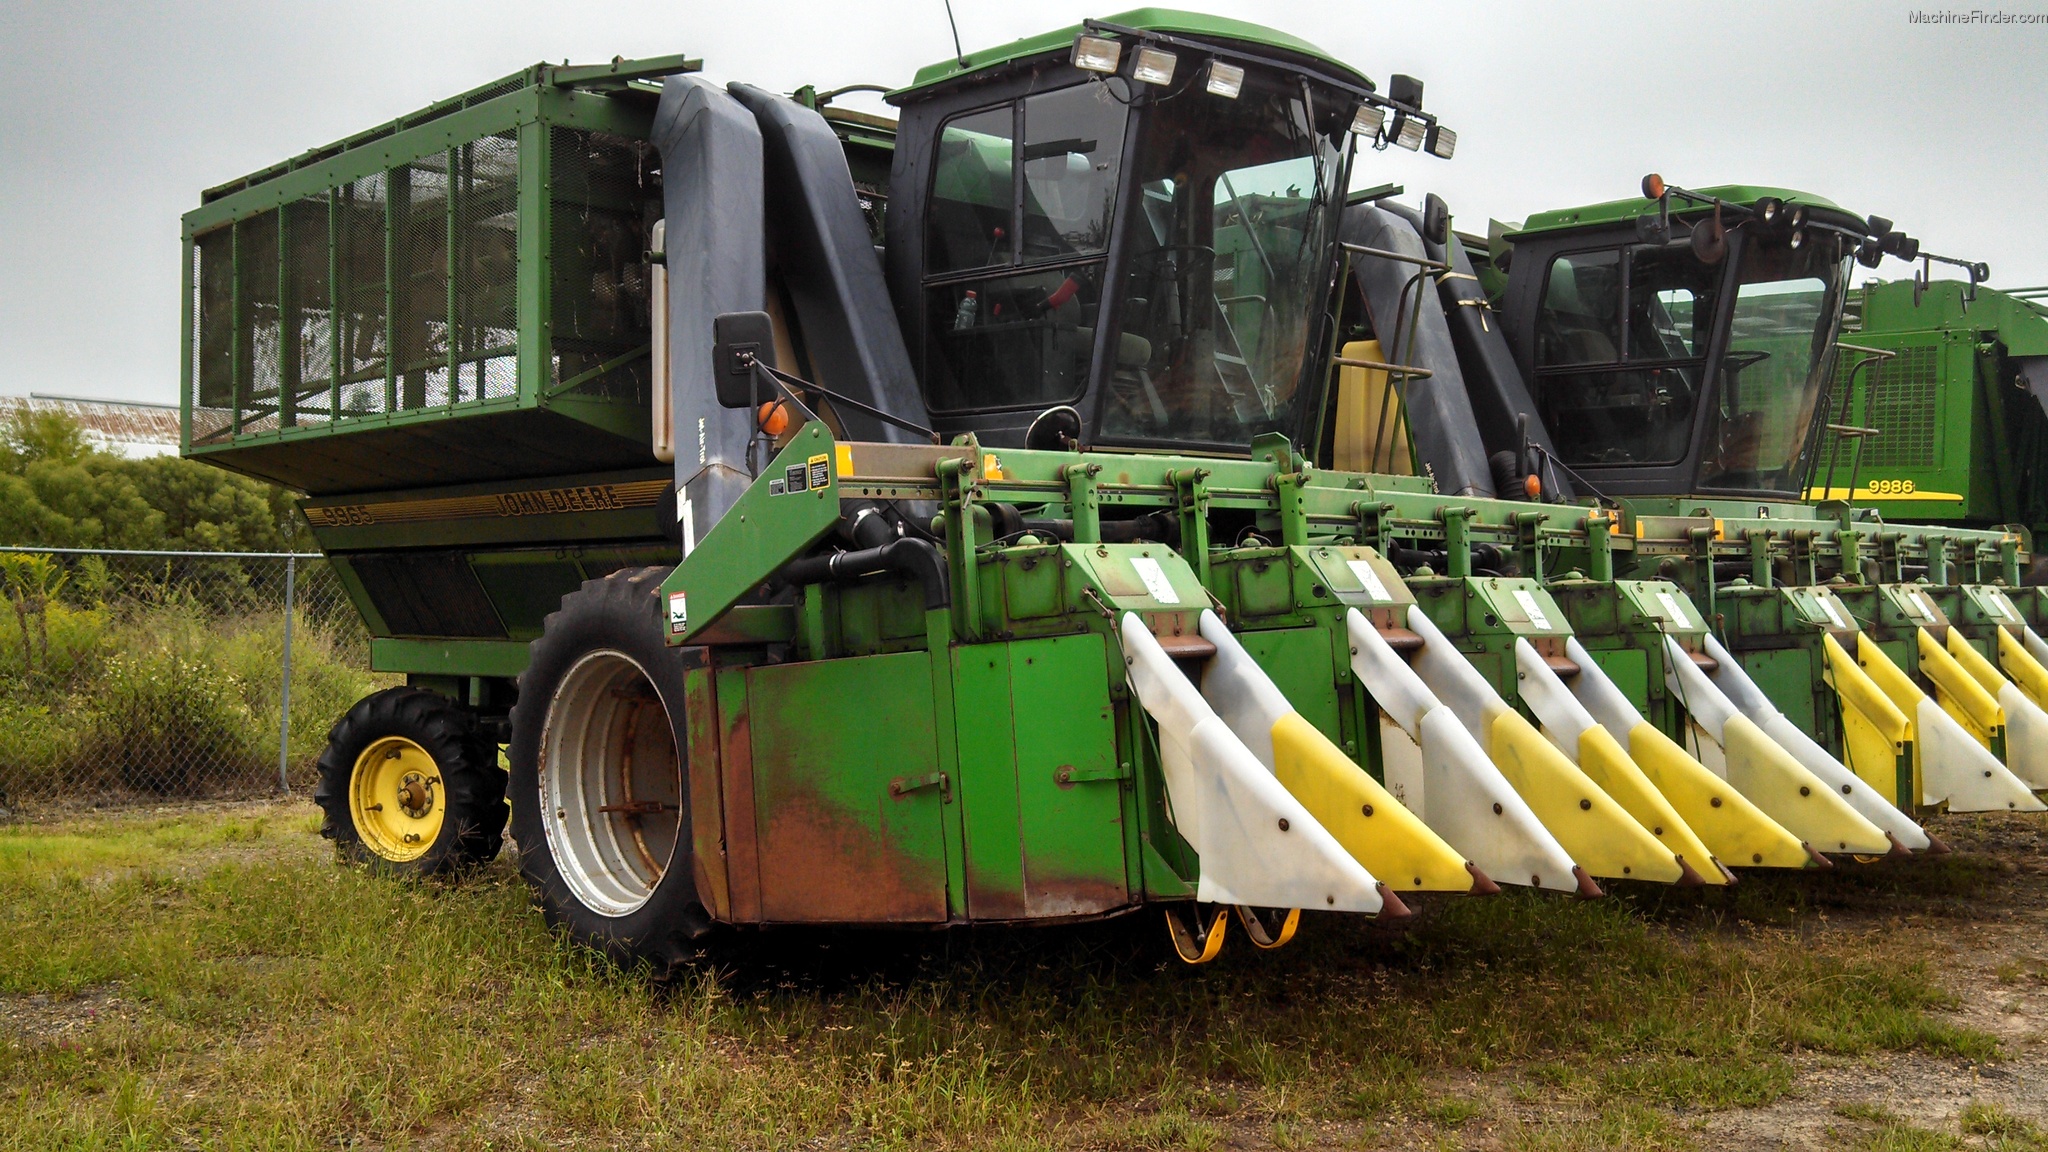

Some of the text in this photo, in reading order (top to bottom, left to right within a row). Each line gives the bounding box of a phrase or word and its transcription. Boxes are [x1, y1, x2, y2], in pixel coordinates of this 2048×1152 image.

[1869, 479, 1914, 494] 9986
[496, 485, 624, 517] JOHN DEERE
[322, 505, 375, 527] 9965
